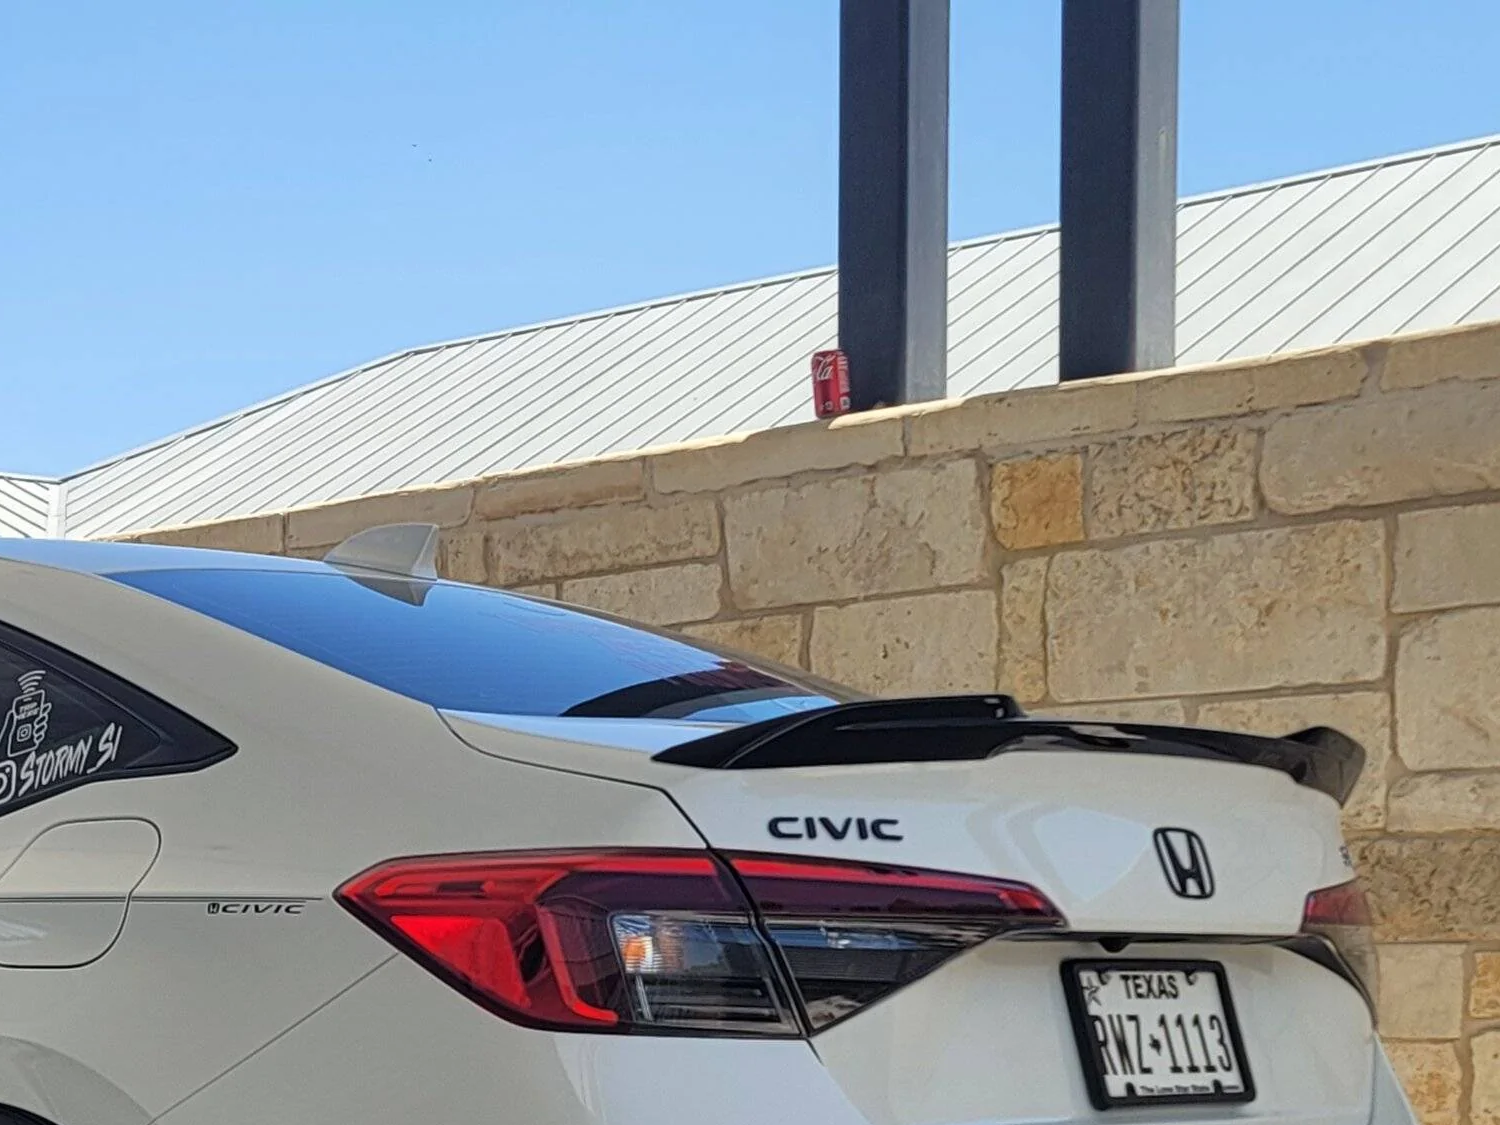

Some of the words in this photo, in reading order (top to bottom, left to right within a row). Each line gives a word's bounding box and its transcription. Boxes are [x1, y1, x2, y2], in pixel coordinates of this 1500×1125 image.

[18, 734, 94, 797] STORMY
[767, 816, 904, 842] CIVIC
[221, 903, 305, 915] CIVIC
[1120, 973, 1180, 1000] TEXAS
